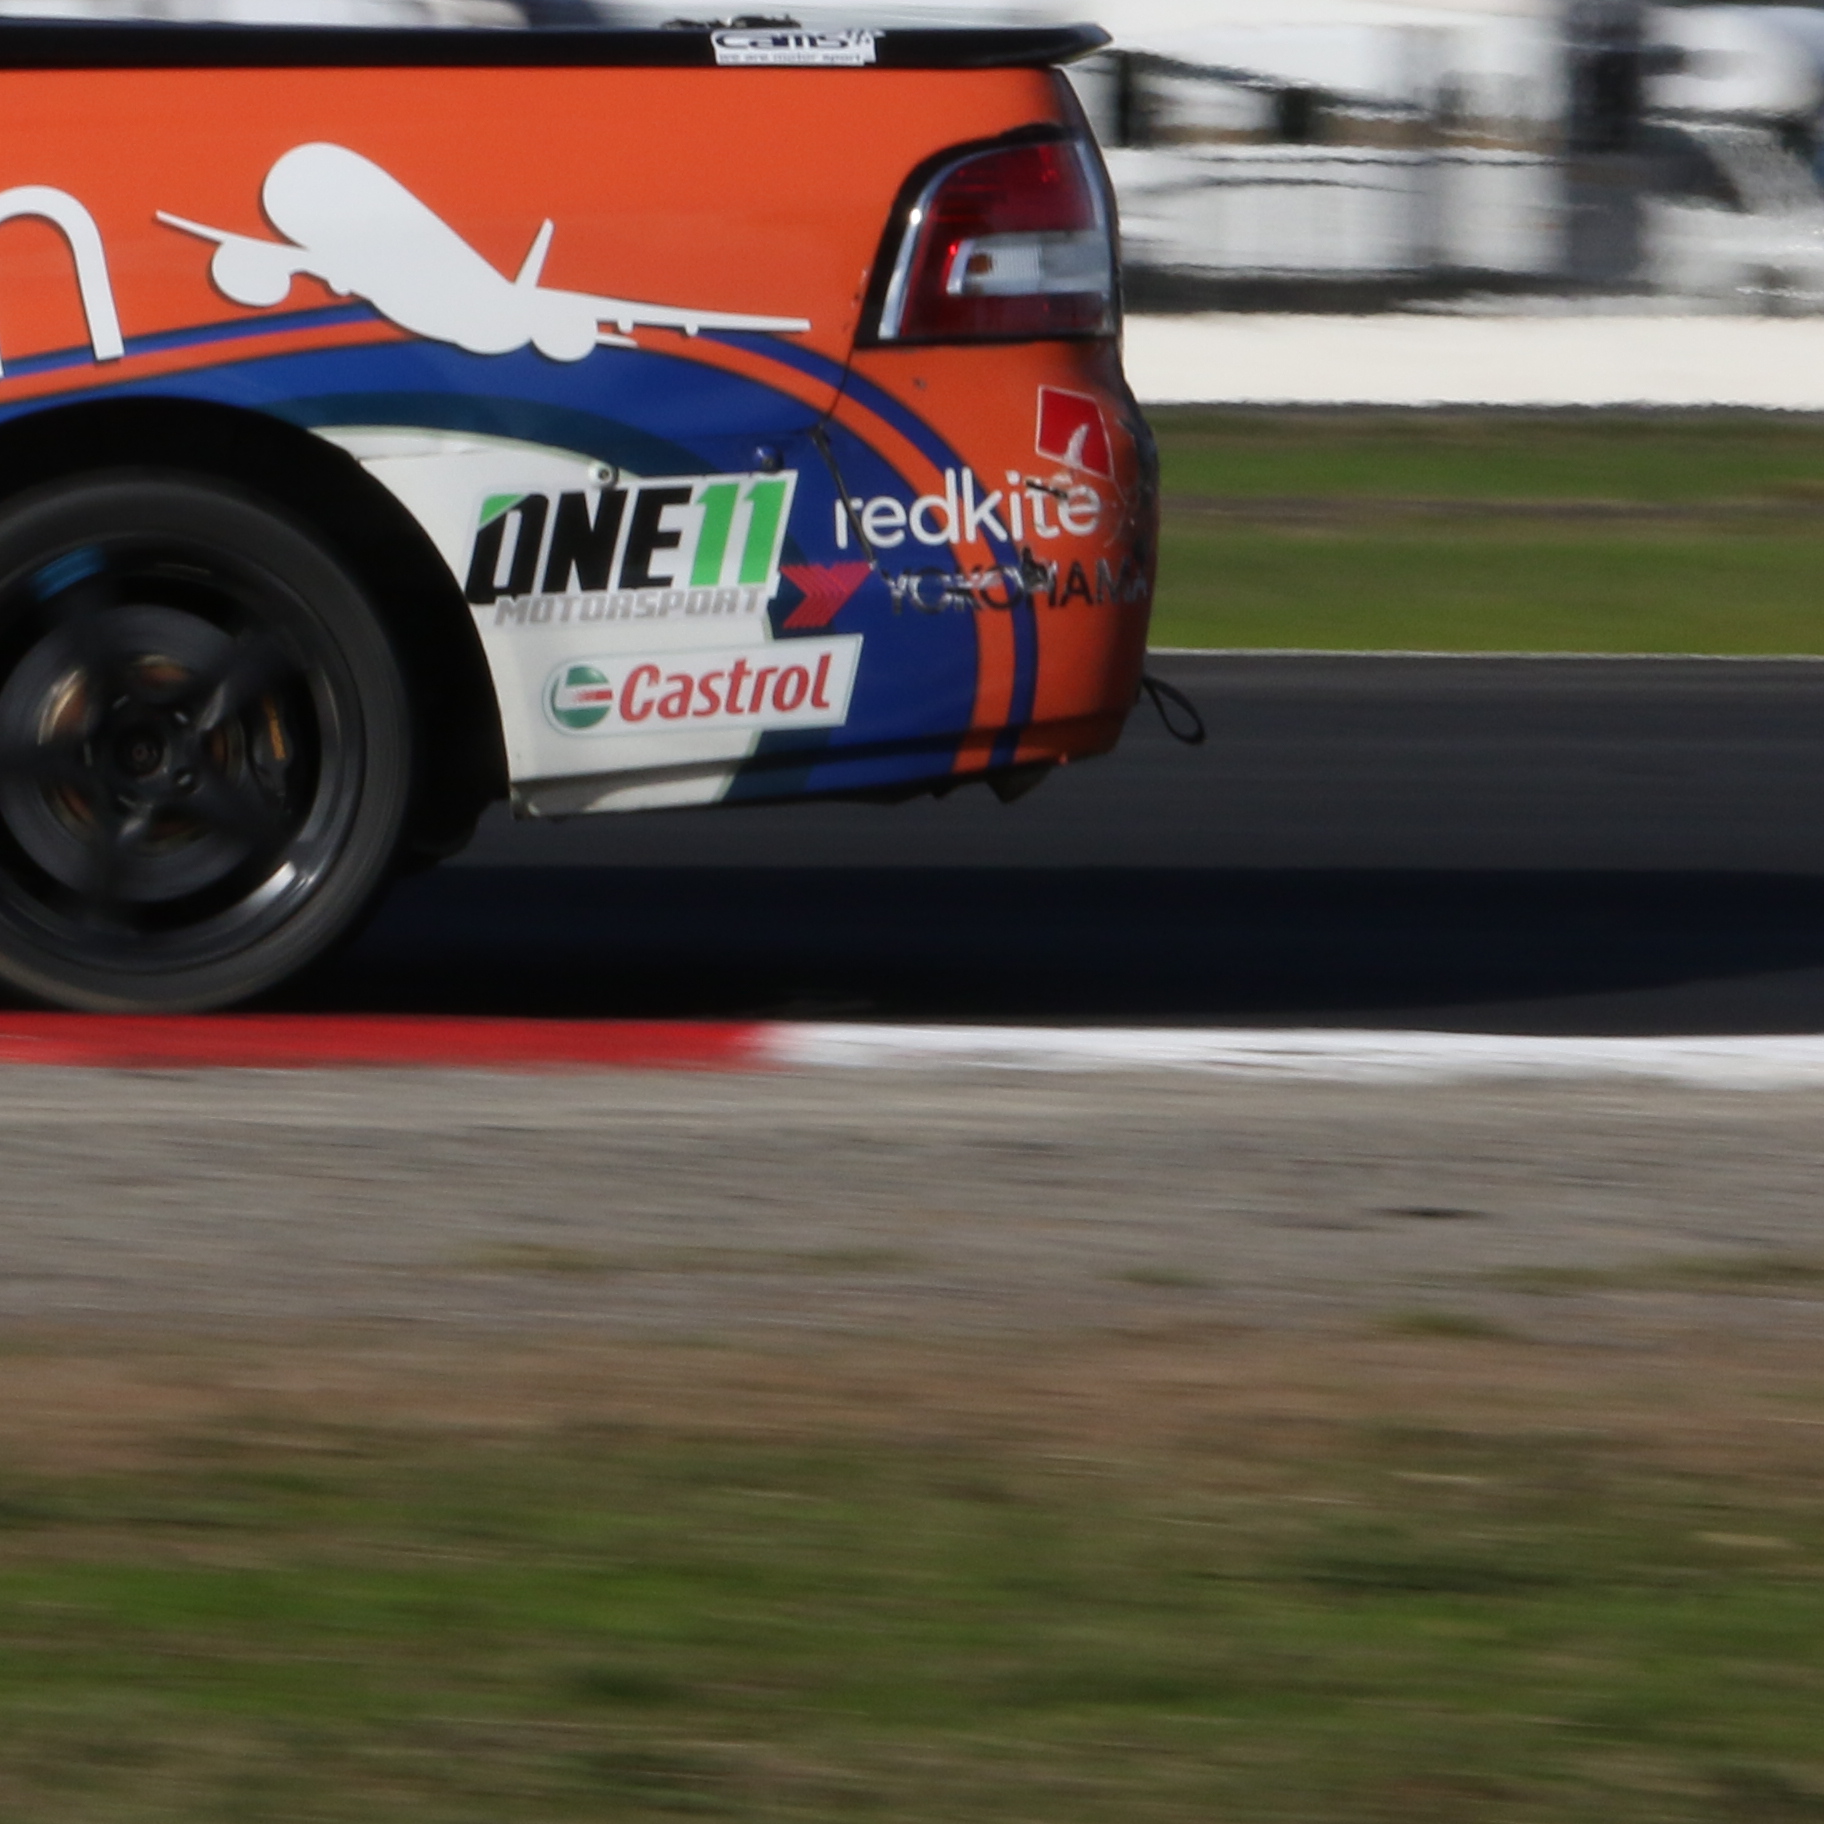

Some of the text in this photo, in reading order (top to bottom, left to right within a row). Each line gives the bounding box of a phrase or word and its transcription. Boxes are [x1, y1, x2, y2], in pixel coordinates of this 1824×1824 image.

[834, 466, 1102, 549] redkite
[494, 586, 765, 627] MOTORSPORT
[618, 651, 833, 723] Castrol
